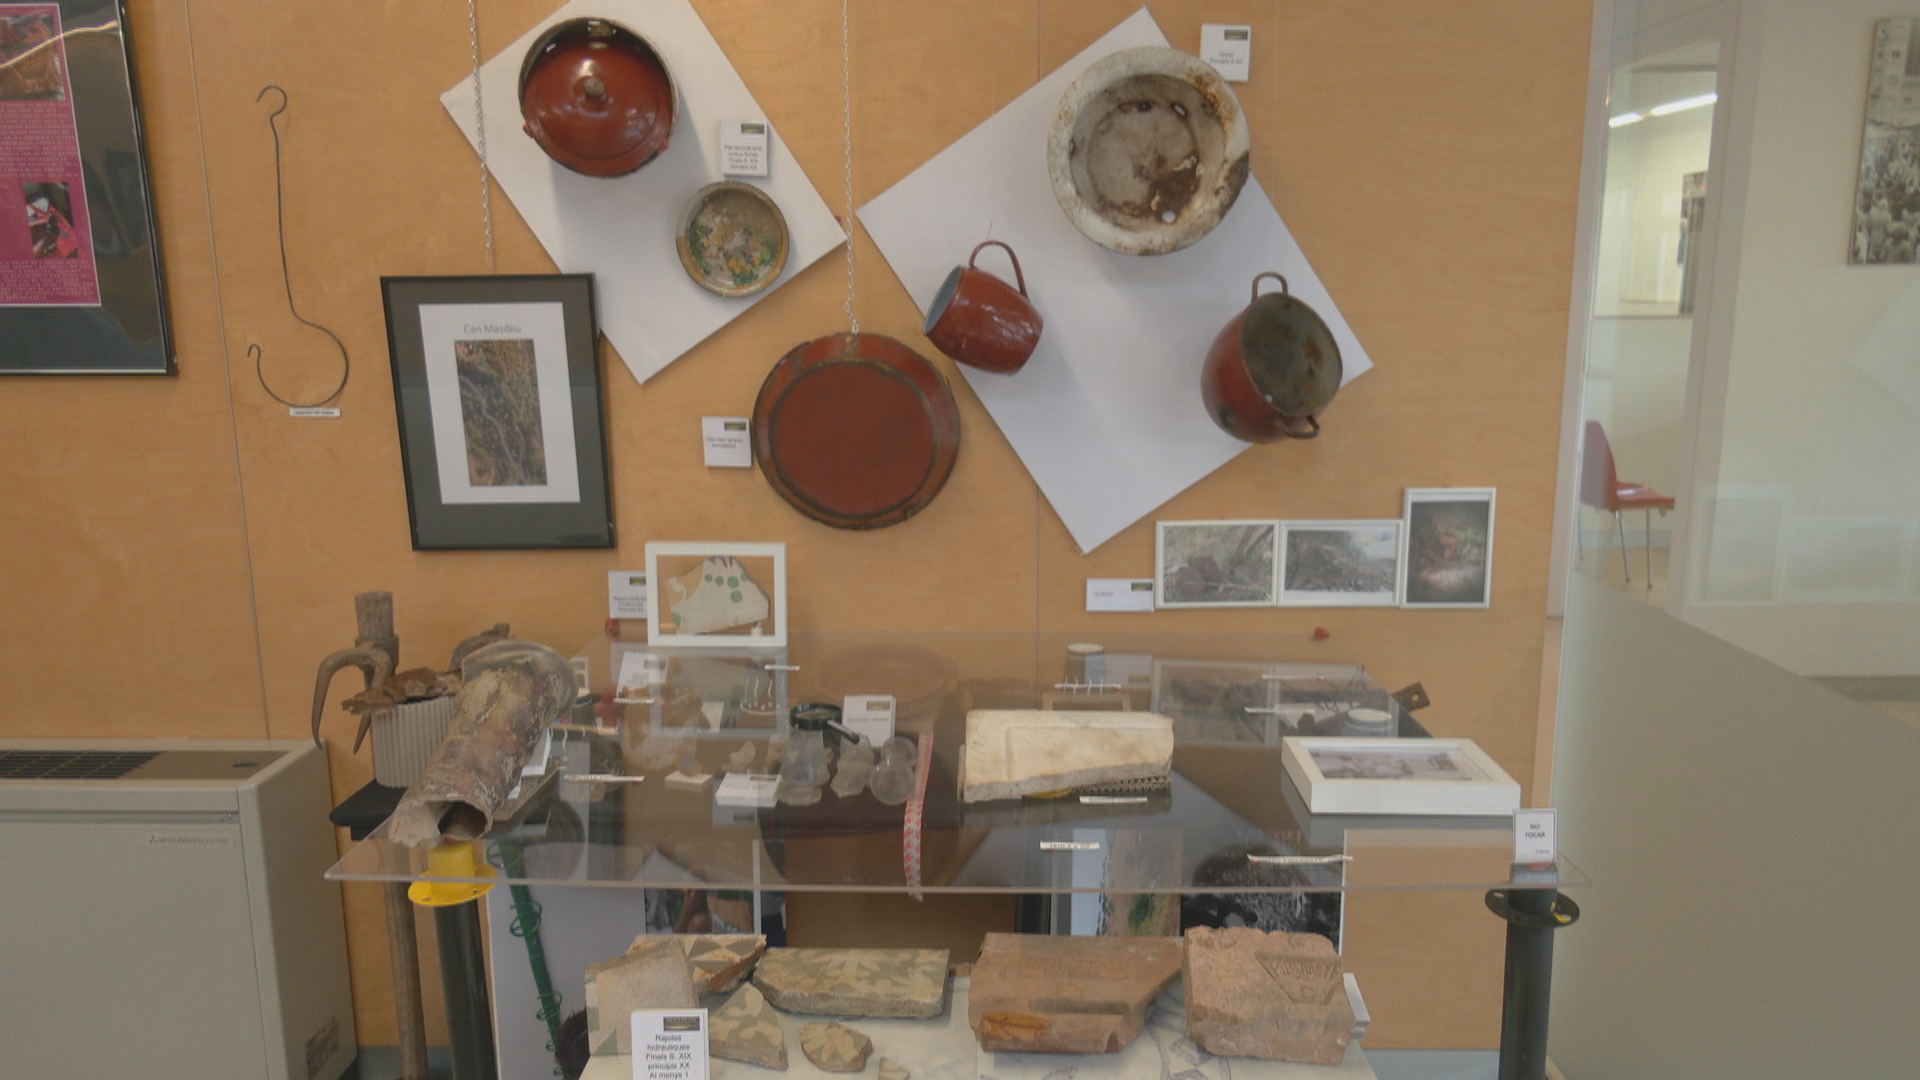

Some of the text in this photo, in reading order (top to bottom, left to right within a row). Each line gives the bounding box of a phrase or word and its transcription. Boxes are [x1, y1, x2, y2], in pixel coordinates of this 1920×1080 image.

[463, 323, 522, 335] Can Masdeu
[655, 1034, 682, 1043] Rajoles
[645, 1052, 667, 1061] Finals
[678, 1052, 692, 1060] XIX
[647, 1061, 690, 1071] principis XX
